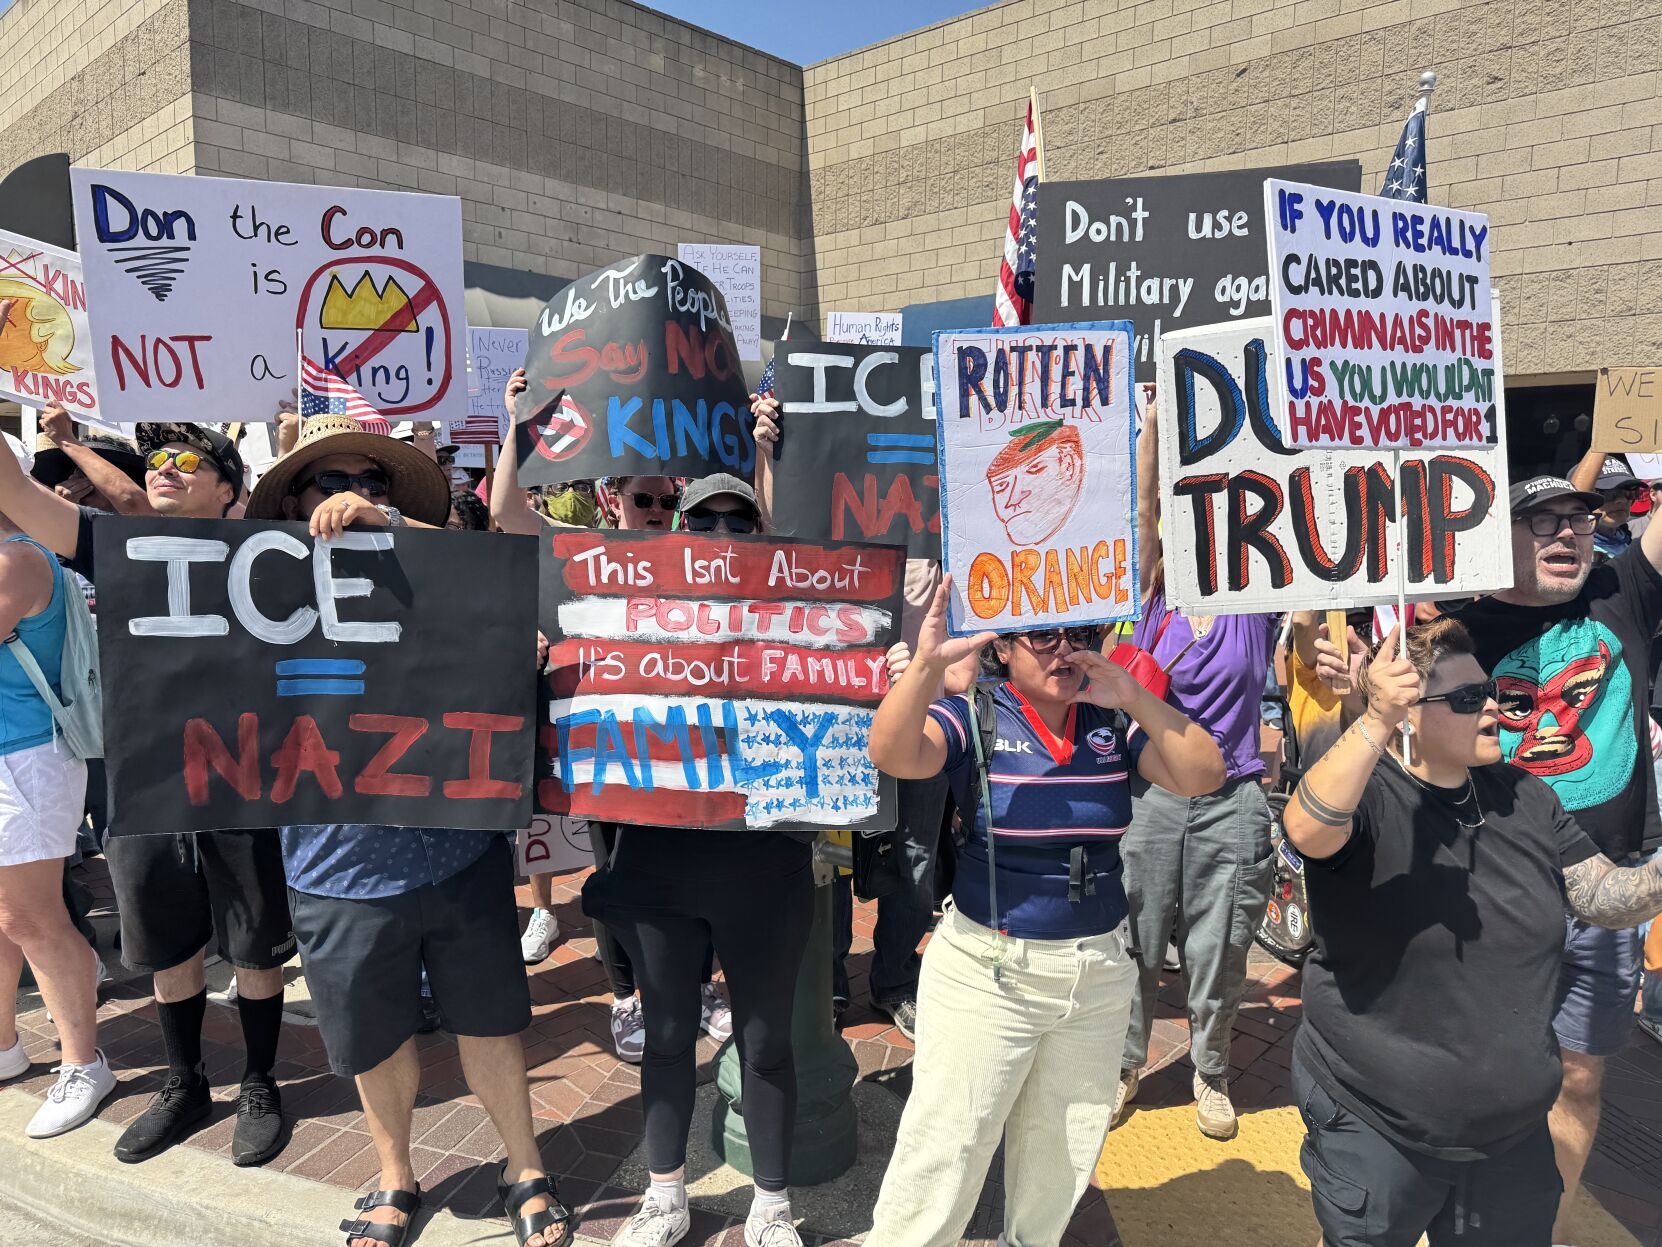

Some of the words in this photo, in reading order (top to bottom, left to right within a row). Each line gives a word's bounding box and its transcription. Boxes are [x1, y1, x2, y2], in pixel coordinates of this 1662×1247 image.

[91, 184, 196, 243] Don
[229, 204, 298, 245] the
[321, 205, 404, 250] Con
[1065, 197, 1150, 244] Don't
[1187, 209, 1249, 240] use
[1278, 189, 1304, 234] IF
[1315, 199, 1380, 248] YOU
[1392, 211, 1488, 263] REALLY
[43, 264, 86, 312] KIN
[252, 263, 287, 295] is
[733, 263, 754, 274] CAN
[1060, 261, 1194, 317] Military
[1214, 273, 1271, 316] aga
[1282, 253, 1384, 299] CARED
[1392, 261, 1479, 311] ABOUT
[539, 286, 596, 337] We
[591, 262, 658, 311] The
[724, 293, 755, 303] ITIES,
[730, 310, 758, 318] EEPING
[478, 330, 522, 353] Never
[833, 313, 871, 336] Human
[875, 316, 900, 337] Rights
[1283, 307, 1432, 354] CRIMINALS
[1434, 312, 1456, 353] IN
[1456, 319, 1493, 360] THE
[111, 334, 212, 390] NOT
[250, 353, 286, 380] a
[542, 329, 647, 389] Say
[664, 320, 737, 381] NO
[11, 366, 95, 409] KINGS
[957, 343, 1115, 419] ROTTEN
[1173, 338, 1304, 467] DU
[1329, 359, 1388, 405] YOU
[1390, 357, 1494, 403] WOULDNT
[1607, 371, 1655, 398] WE
[608, 395, 755, 474] KINGS
[1288, 399, 1364, 445] HAVE
[1364, 401, 1439, 447] VOTED
[1441, 405, 1483, 442] FOR
[1615, 417, 1658, 445] SI
[831, 472, 940, 541] NA
[1173, 455, 1496, 596] TRUMP
[126, 530, 402, 644] ICE
[572, 545, 654, 587] This
[768, 549, 872, 590] About
[968, 538, 1130, 619] ORANGE
[625, 596, 868, 642] POLITICS
[639, 646, 750, 686] about
[761, 649, 887, 693] FAMILY
[183, 712, 525, 806] NAZI
[555, 701, 839, 799] FAMILY
[994, 739, 1032, 753] BLK
[525, 819, 551, 865] DU
